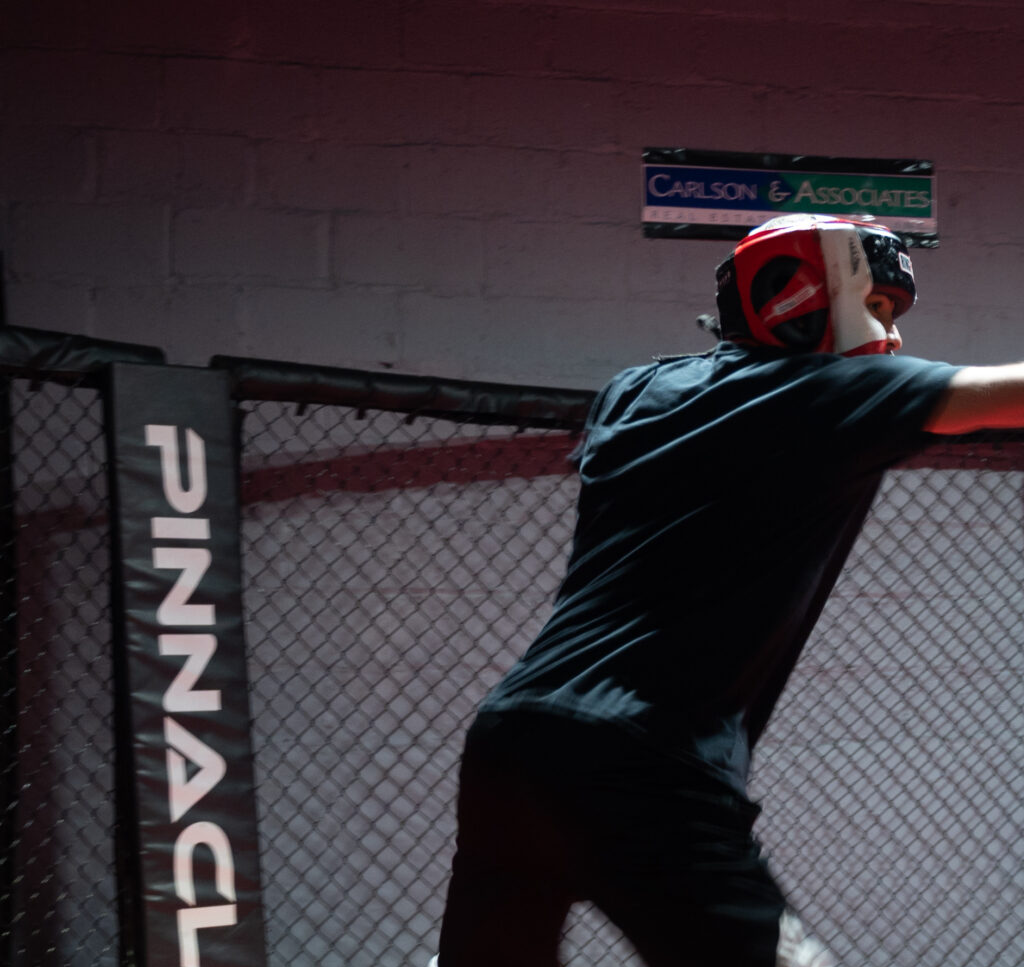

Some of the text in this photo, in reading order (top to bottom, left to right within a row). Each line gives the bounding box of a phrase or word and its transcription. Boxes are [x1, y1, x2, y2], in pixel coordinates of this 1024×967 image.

[648, 173, 931, 209] CARLSON & ASSOCIATES
